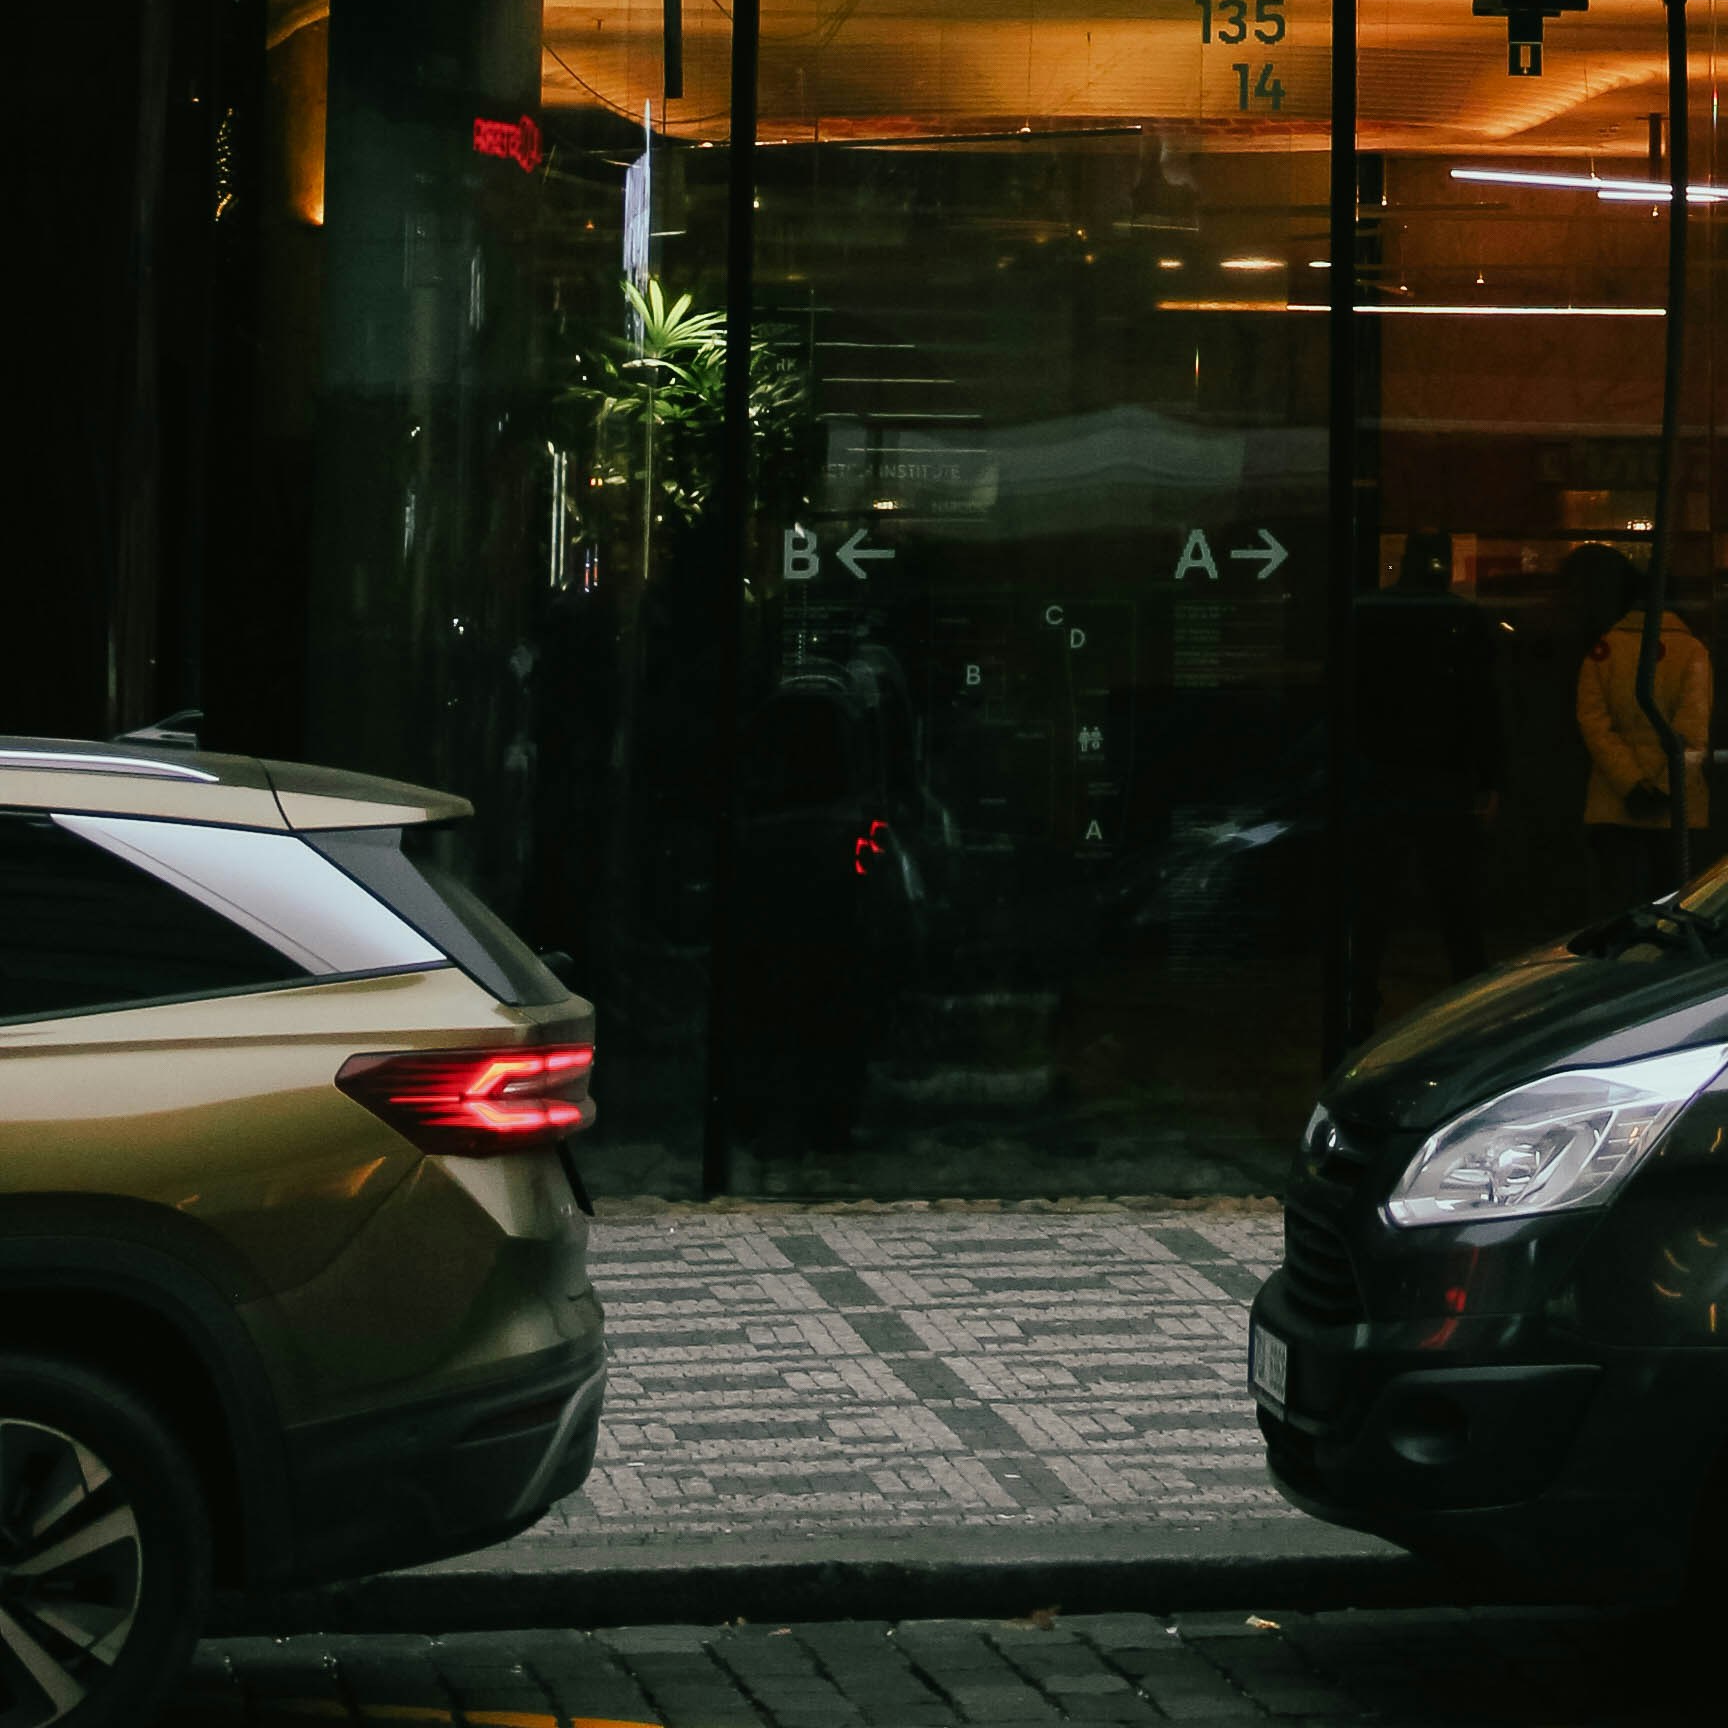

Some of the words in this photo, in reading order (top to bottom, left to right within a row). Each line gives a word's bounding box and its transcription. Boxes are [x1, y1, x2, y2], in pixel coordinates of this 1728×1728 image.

[1232, 63, 1286, 110] 14
[784, 529, 820, 580] B
[1174, 529, 1219, 580] A
[1044, 605, 1065, 626] C
[1069, 629, 1087, 649] D
[965, 664, 982, 686] B
[1084, 820, 1104, 840] A
